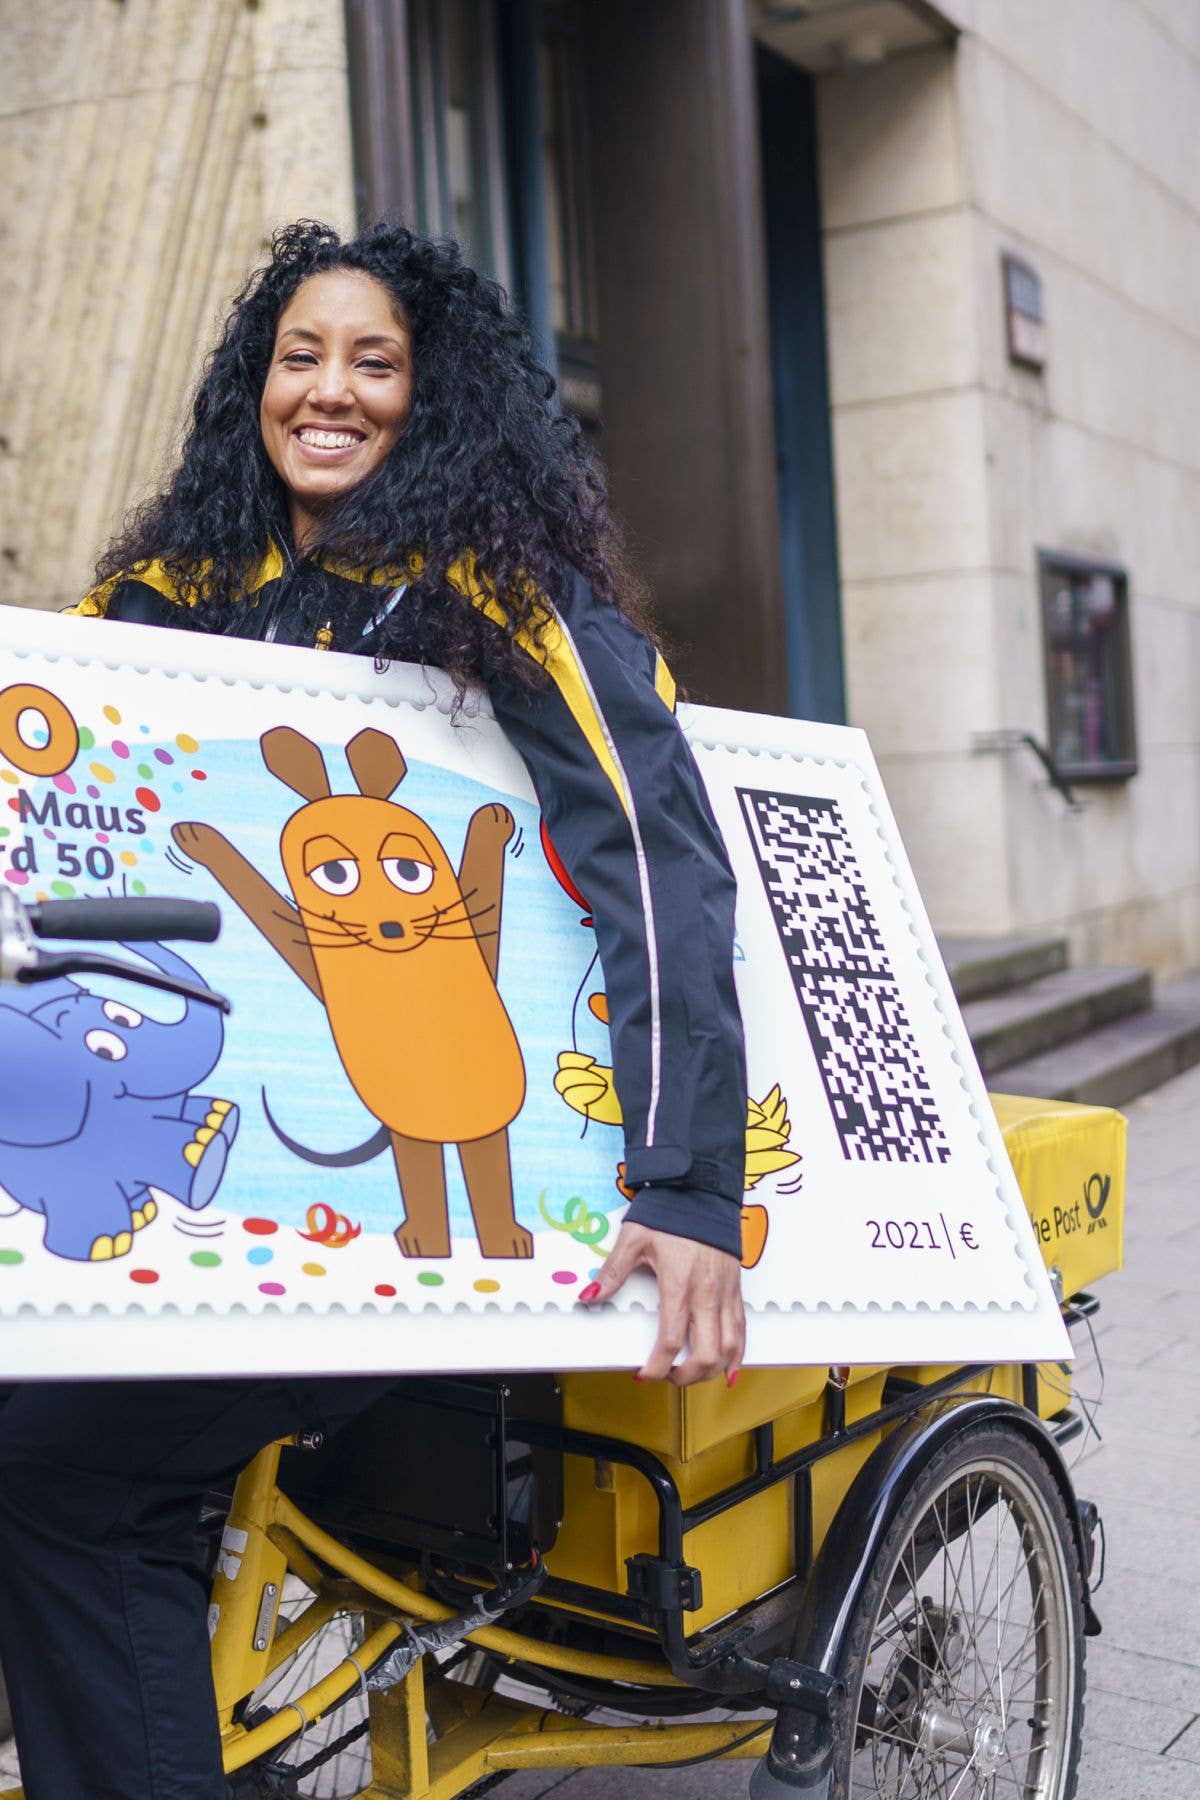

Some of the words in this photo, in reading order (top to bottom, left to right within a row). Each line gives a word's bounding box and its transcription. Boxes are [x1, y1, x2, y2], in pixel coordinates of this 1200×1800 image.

[17, 788, 147, 835] Maus
[56, 842, 115, 881] 50
[1053, 1200, 1081, 1239] Post
